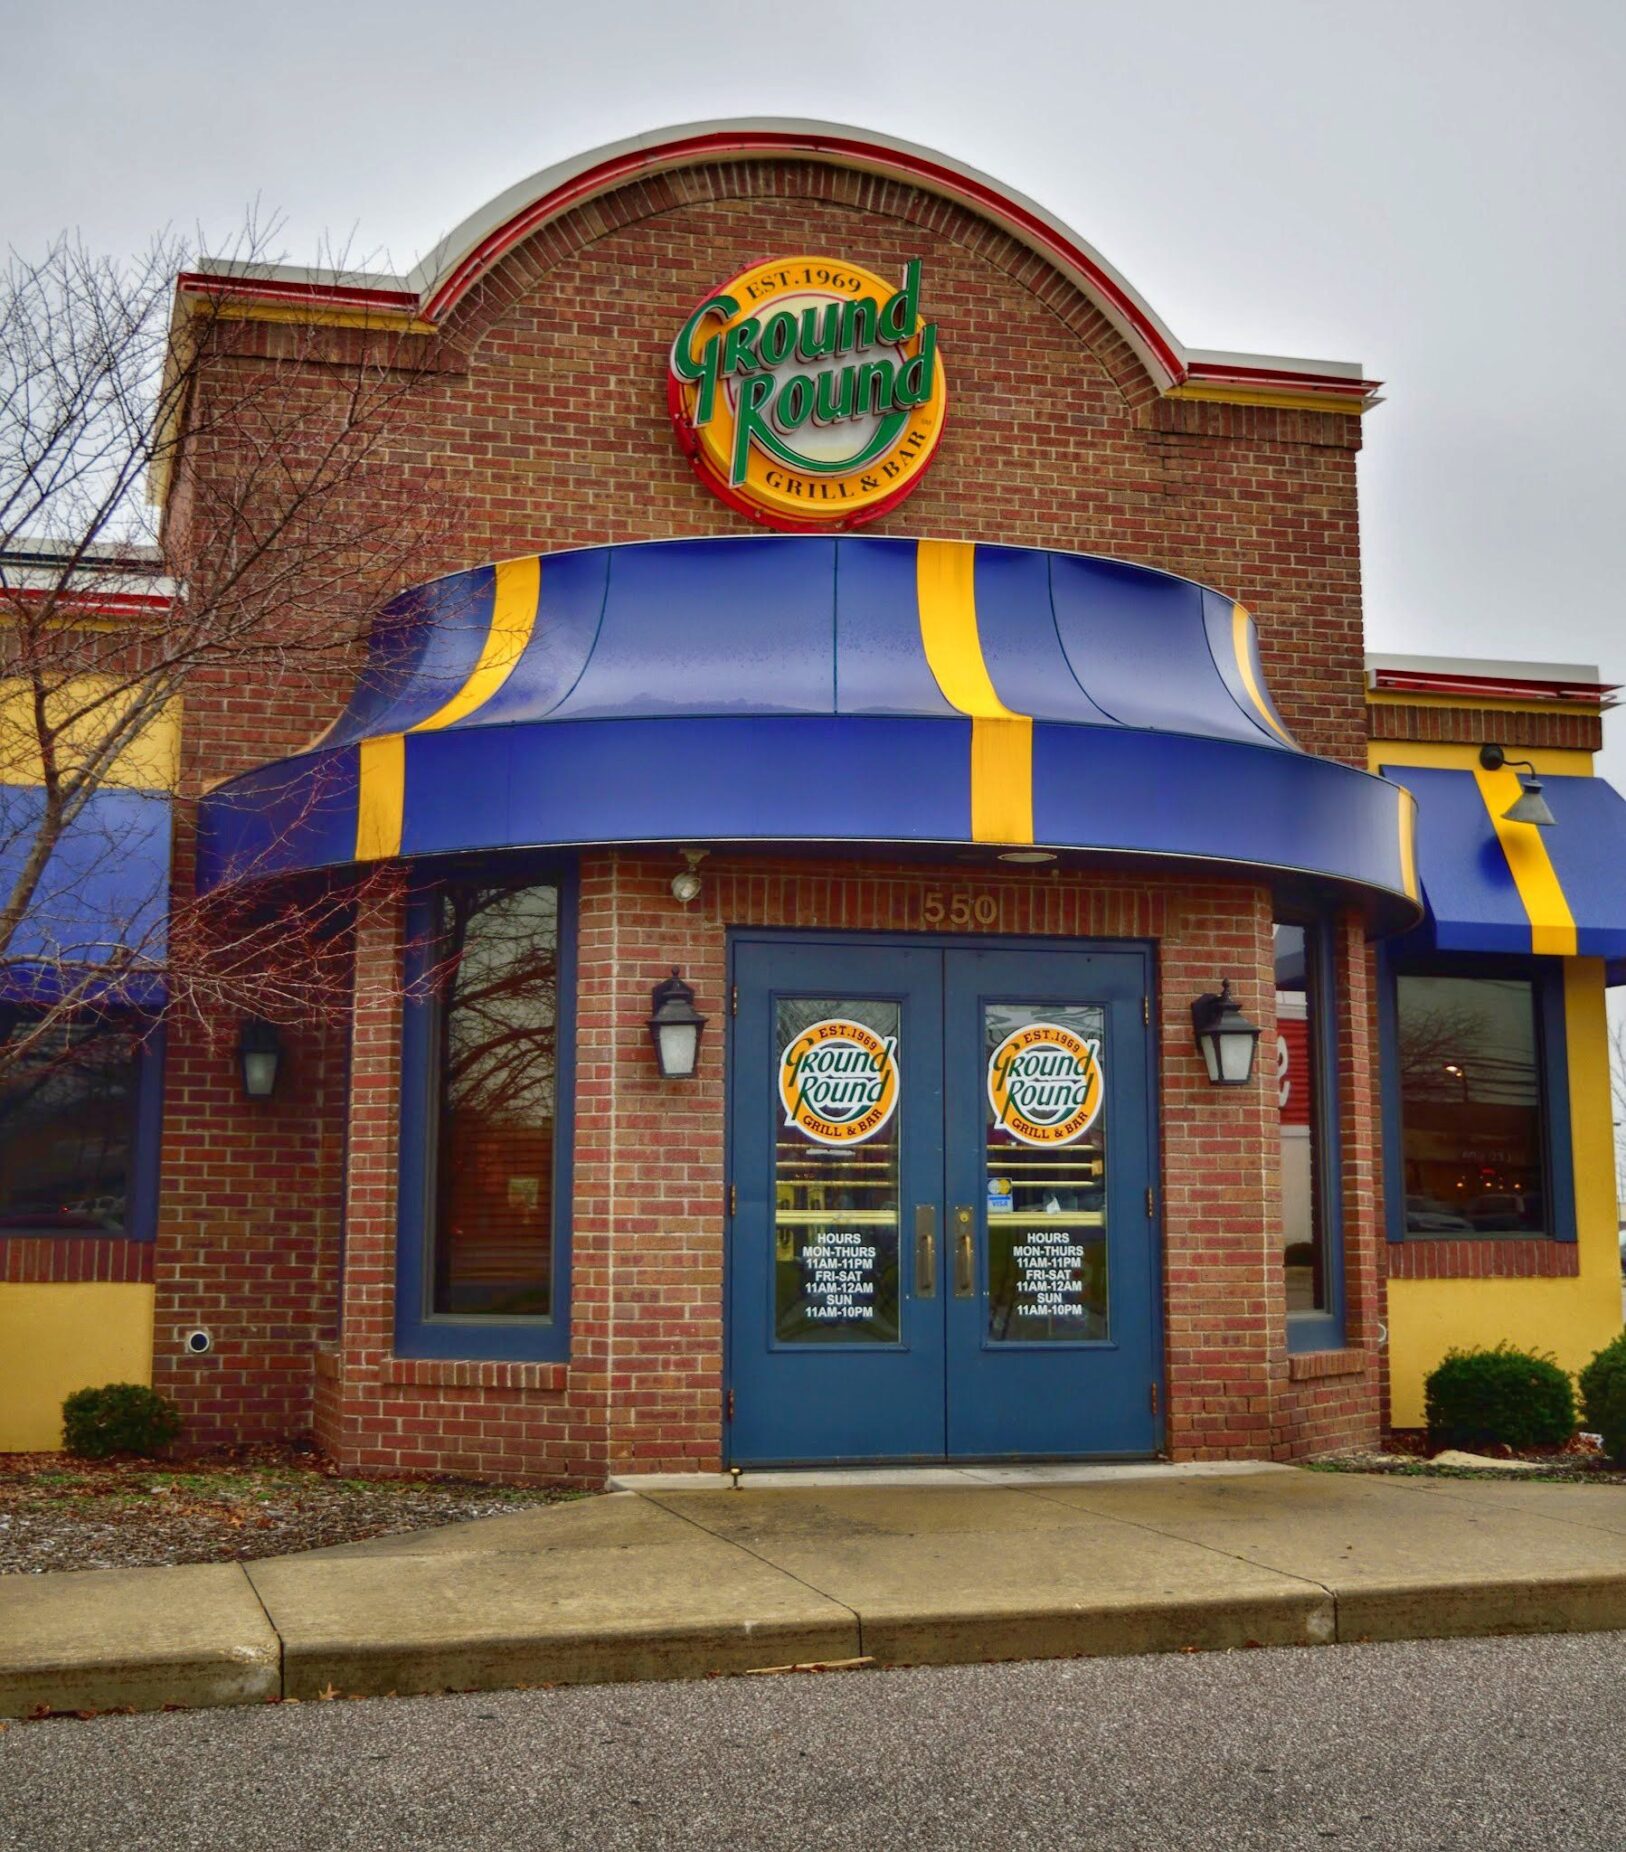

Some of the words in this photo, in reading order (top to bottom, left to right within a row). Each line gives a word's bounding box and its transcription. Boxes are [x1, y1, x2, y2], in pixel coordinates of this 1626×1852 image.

[729, 322, 938, 488] Round
[765, 470, 854, 500] GRILL
[860, 475, 881, 492] &
[882, 430, 926, 479] BAR
[924, 891, 998, 925] 550
[803, 1115, 842, 1137] GRILL
[847, 1126, 856, 1136] &
[859, 1108, 883, 1132] BAR
[1011, 1117, 1050, 1139] GRILL
[1054, 1129, 1064, 1138] &
[1066, 1111, 1088, 1134] BAR
[817, 1233, 862, 1244] HOURS
[1027, 1233, 1070, 1243] HOURS
[802, 1246, 876, 1257] MON-THURS
[1013, 1246, 1084, 1256] MON-THURS
[806, 1258, 873, 1269] 11AM-11PM
[1016, 1257, 1081, 1268] 11AM-11PM
[815, 1271, 863, 1282] FRI-SAT
[1026, 1270, 1072, 1280] FRI-SAT
[805, 1282, 873, 1293] 11AM-12AM
[1016, 1281, 1082, 1292] 11AM-12AM
[826, 1294, 853, 1305] SUN
[1036, 1293, 1062, 1303] SUN
[805, 1306, 873, 1317] 11AM-10PM
[1016, 1304, 1083, 1315] 11AM-10PM
